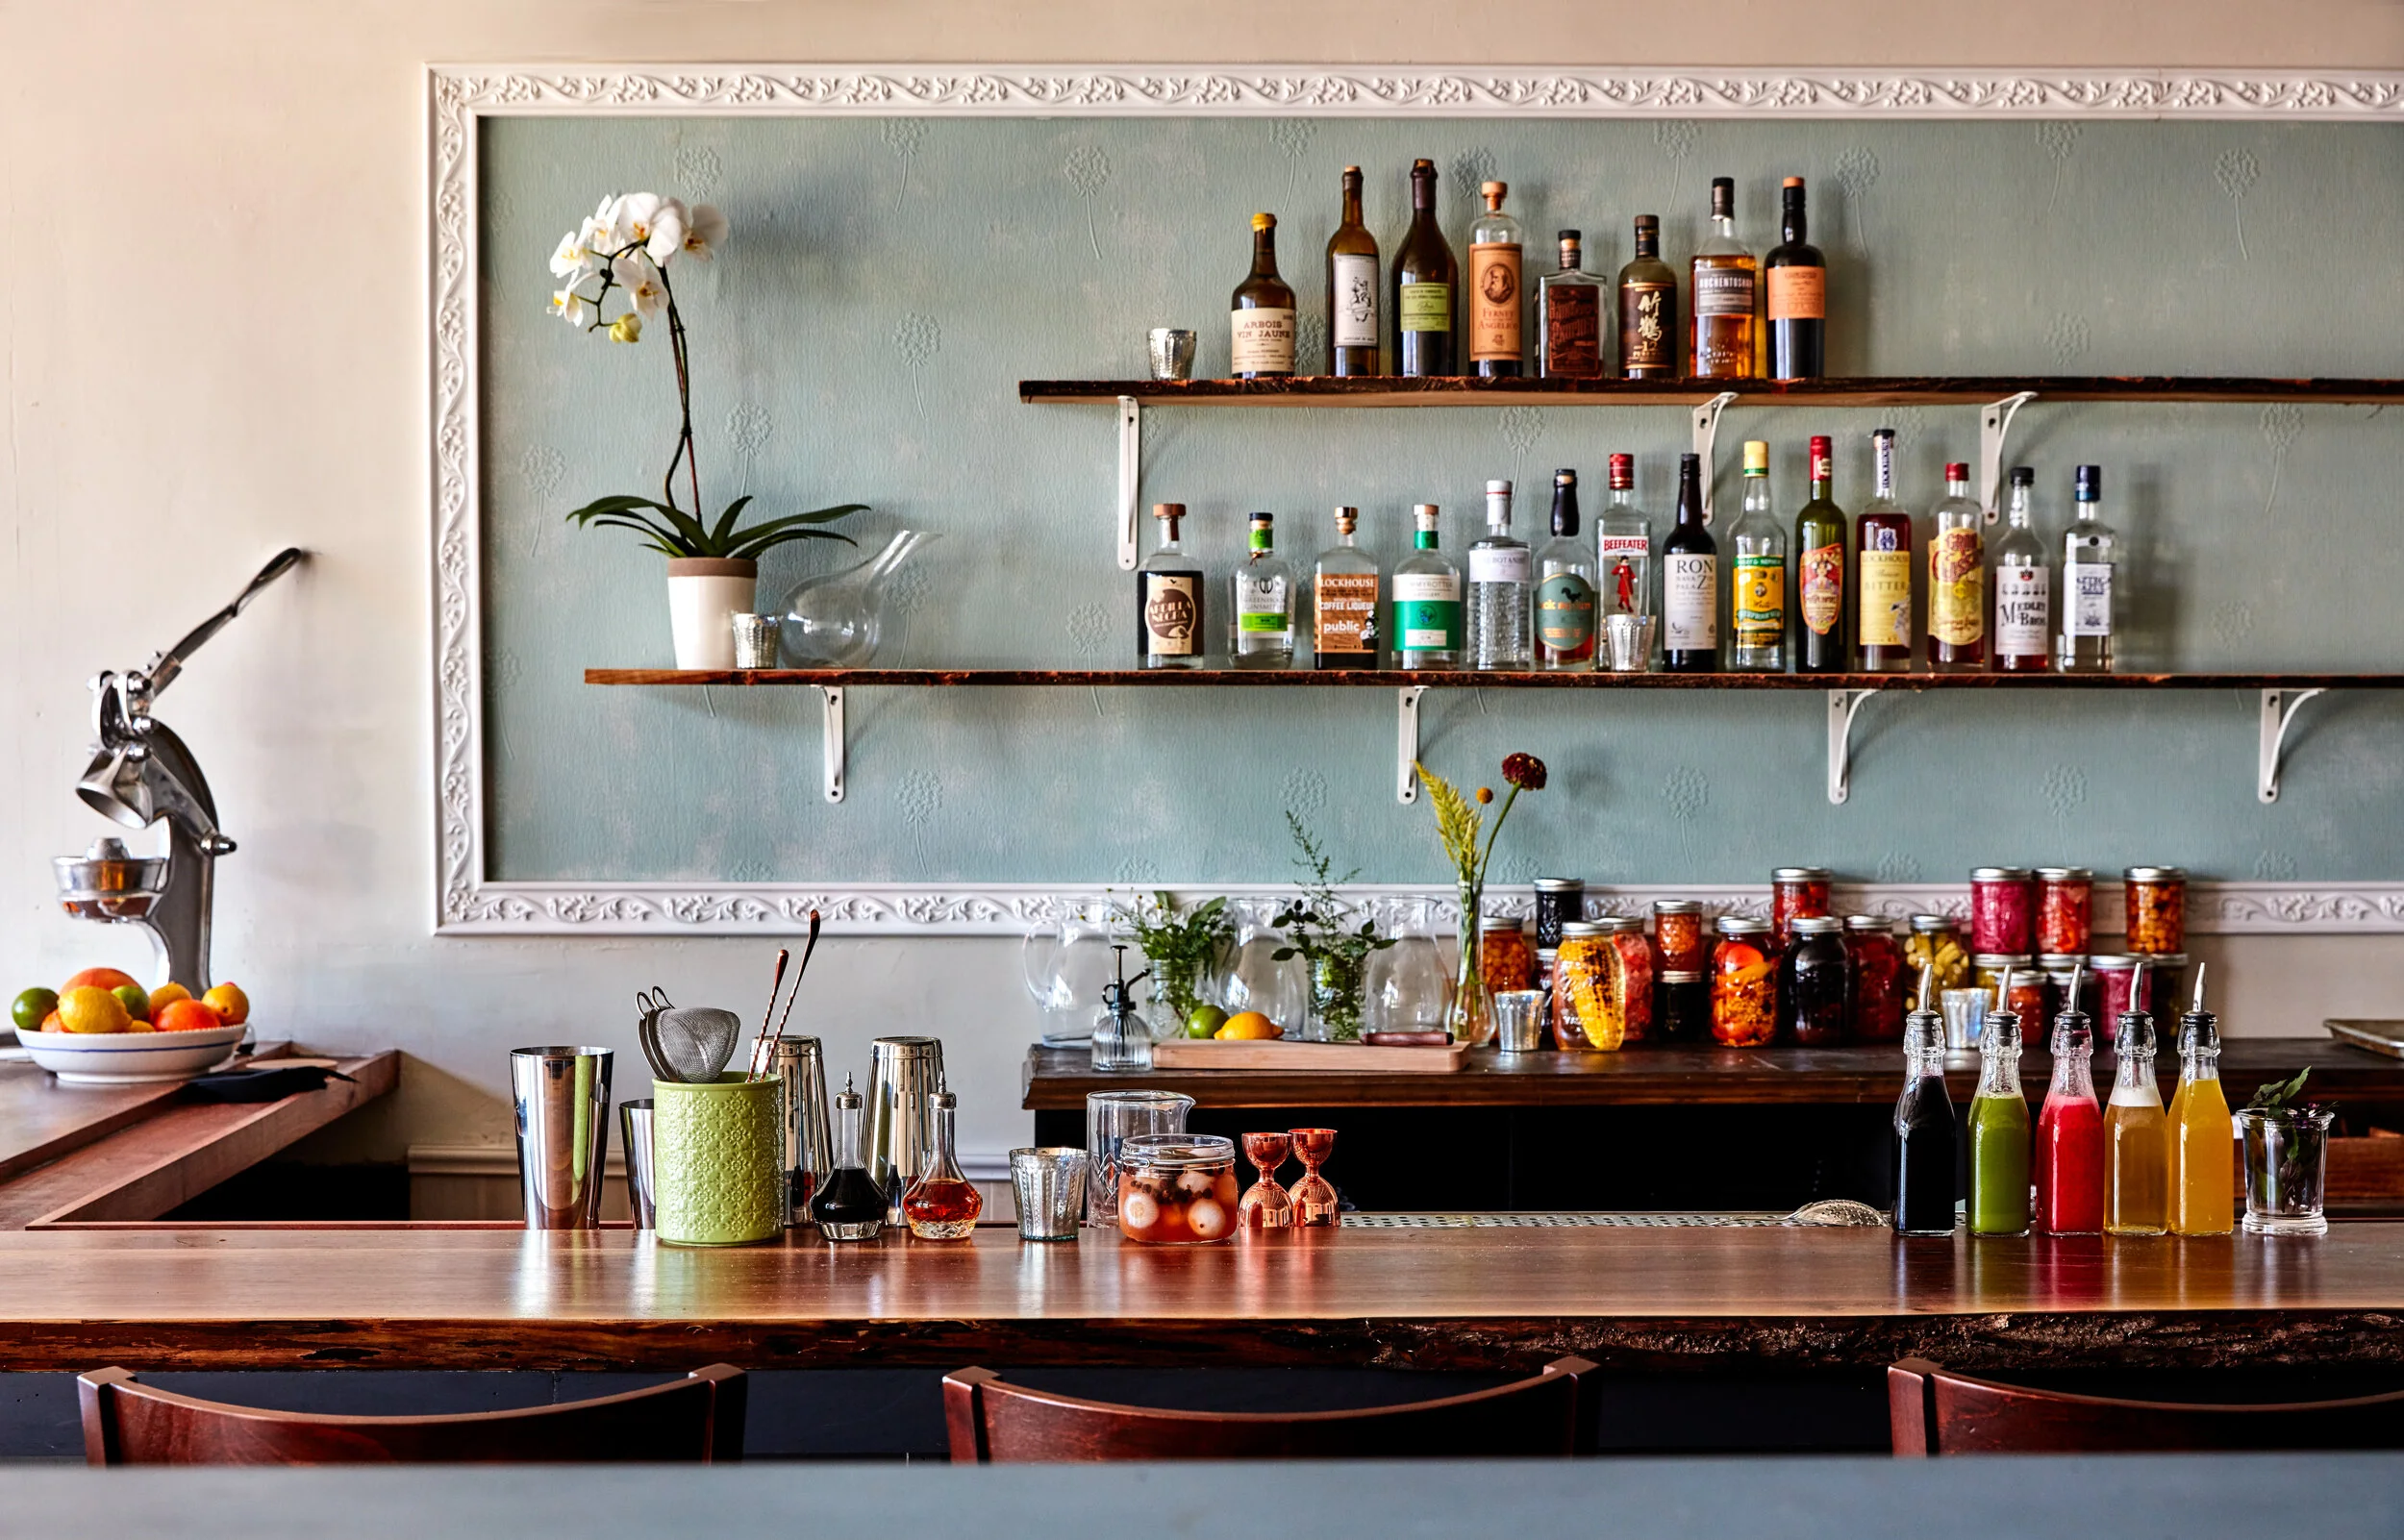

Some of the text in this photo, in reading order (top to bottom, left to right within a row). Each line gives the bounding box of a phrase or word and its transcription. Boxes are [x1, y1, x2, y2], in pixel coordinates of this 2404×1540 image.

[1243, 320, 1283, 329] ARBOIS
[1258, 330, 1290, 338] JAUNE
[1604, 539, 1648, 552] BEEFEATER
[1676, 559, 1714, 574] RON
[1320, 578, 1374, 587] LOCKHOUSE
[1864, 582, 1907, 591] BITTER
[1320, 601, 1344, 610] COFFEE
[1323, 620, 1361, 634] public
